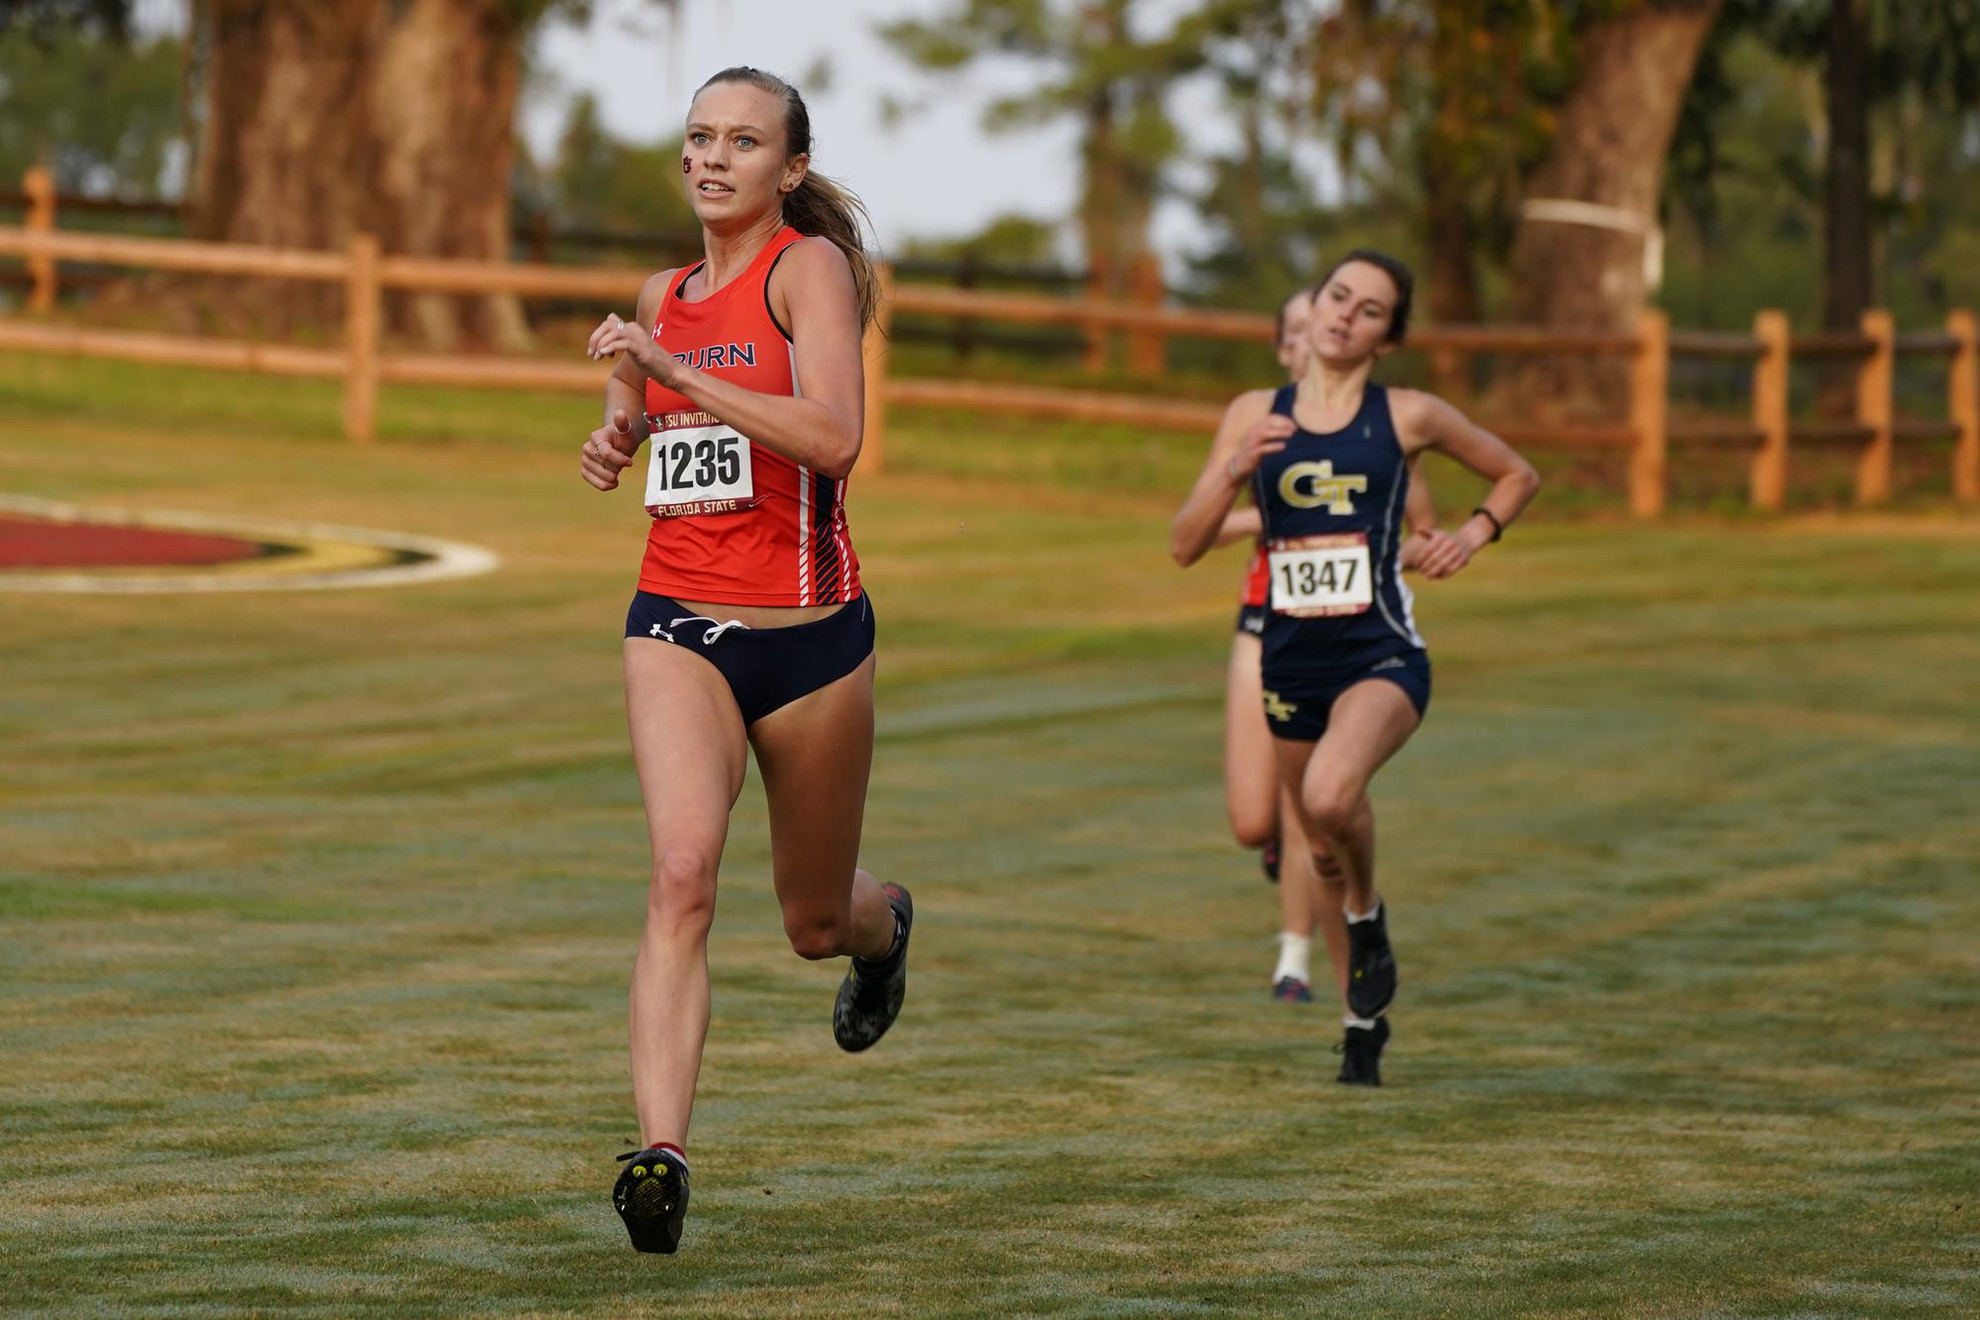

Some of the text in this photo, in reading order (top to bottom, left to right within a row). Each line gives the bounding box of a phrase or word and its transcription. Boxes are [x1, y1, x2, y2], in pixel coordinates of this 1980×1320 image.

[658, 437, 741, 492] 1235
[1277, 458, 1368, 515] GT
[657, 499, 737, 517] FLORIDA STATE
[1281, 558, 1358, 598] 1347
